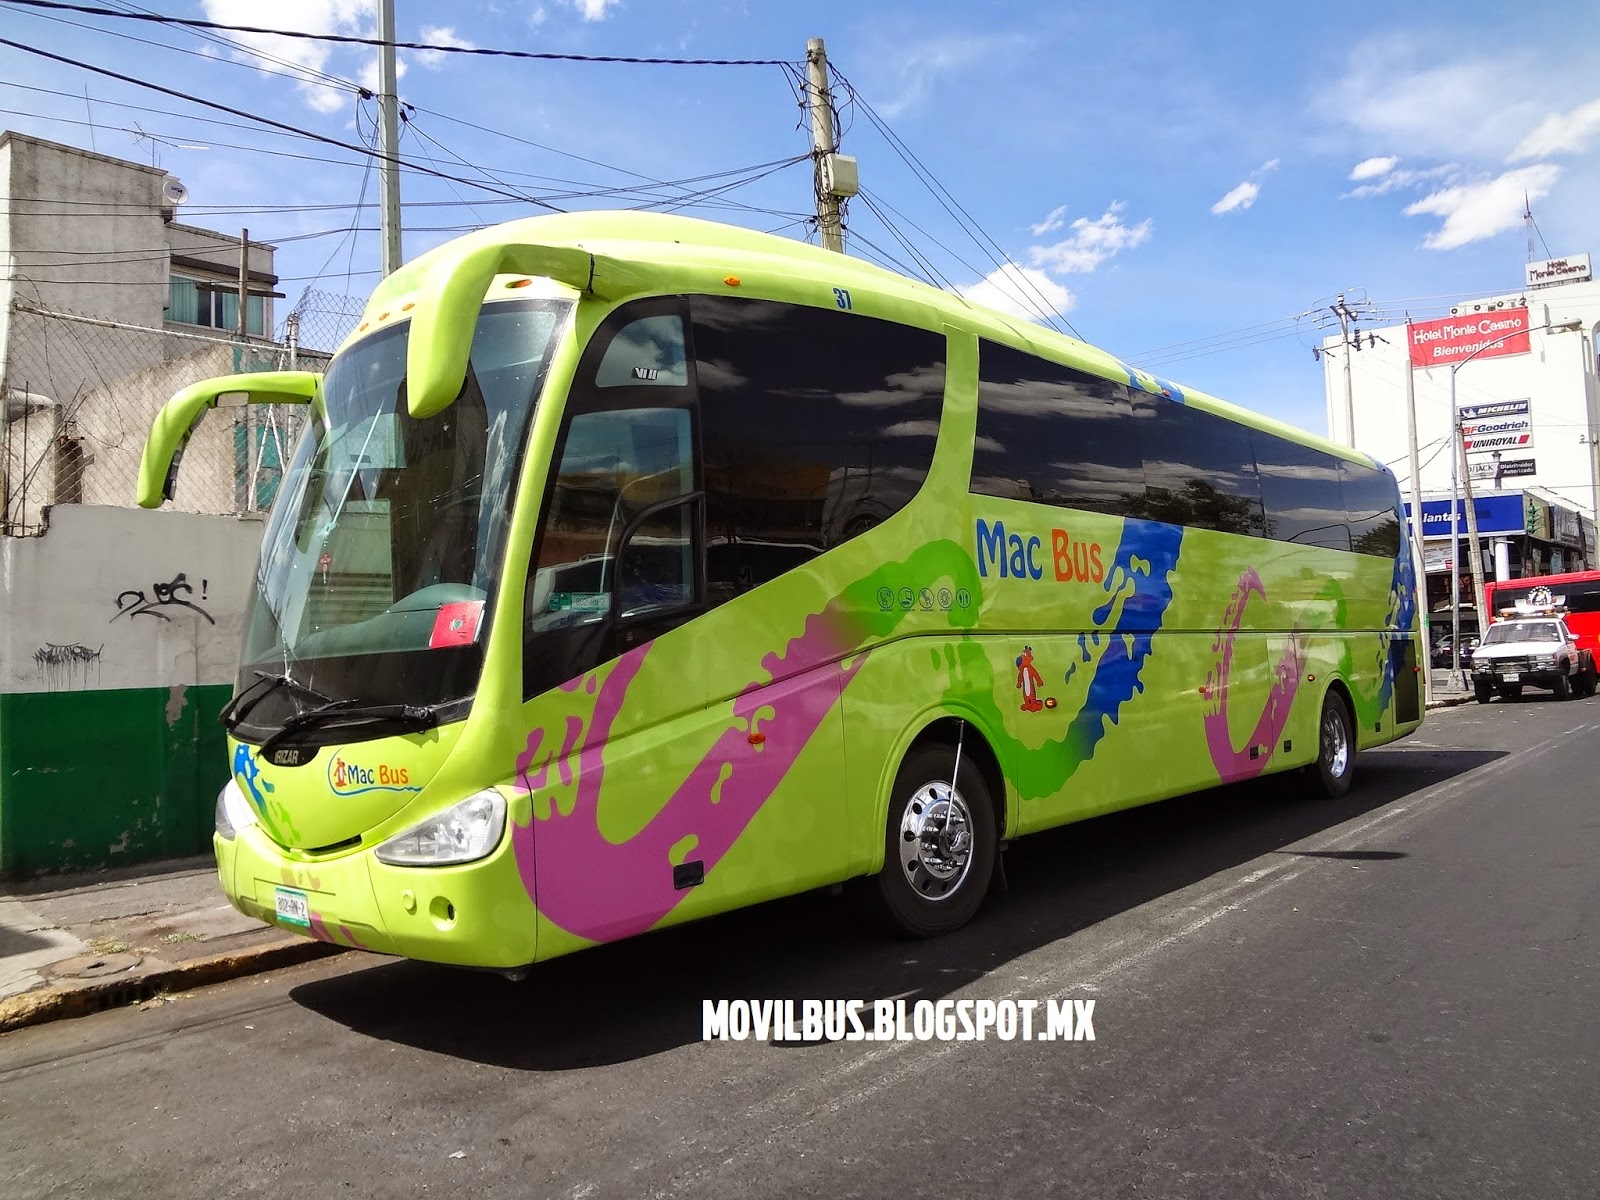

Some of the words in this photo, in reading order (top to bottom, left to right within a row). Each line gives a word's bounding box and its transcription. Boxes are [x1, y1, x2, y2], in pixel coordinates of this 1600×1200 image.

[1547, 259, 1568, 270] Hotel
[833, 288, 852, 310] 37
[1413, 328, 1442, 345] Hotel
[1443, 324, 1477, 340] Monte
[1478, 318, 1522, 334] Casino
[1478, 403, 1527, 414] MICHELIN
[1463, 420, 1528, 435] BFGoodrich
[1472, 436, 1518, 449] UNIROYAL
[976, 518, 1043, 581] Mac
[1051, 528, 1104, 584] Bus
[274, 749, 299, 764] IRIZAR
[347, 764, 375, 785] Mac
[379, 764, 409, 785] Bus
